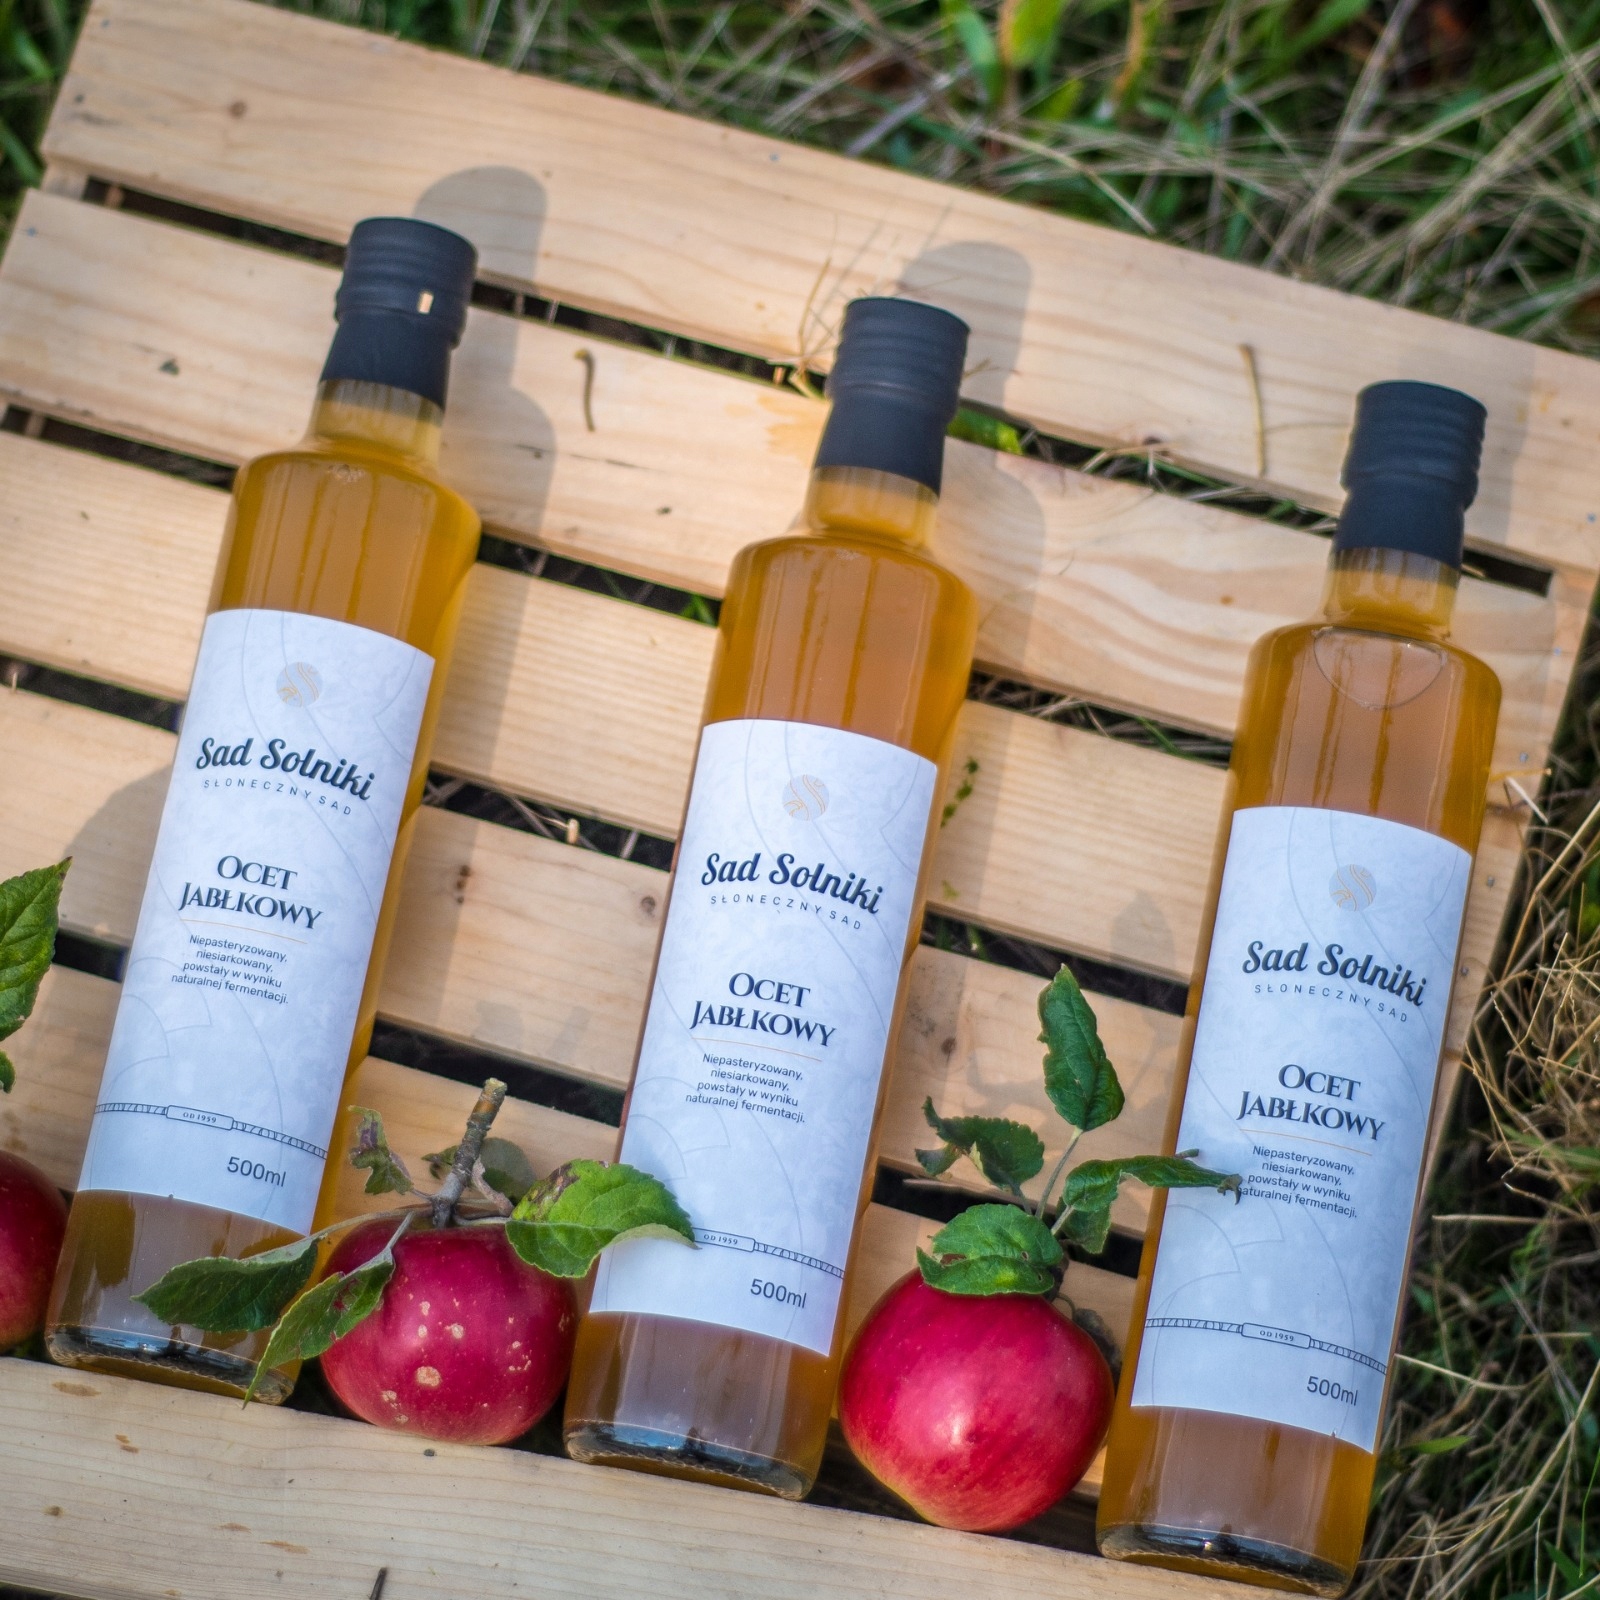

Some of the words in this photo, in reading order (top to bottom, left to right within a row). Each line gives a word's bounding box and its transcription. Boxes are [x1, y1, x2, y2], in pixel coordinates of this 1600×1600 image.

[196, 737, 254, 770] Sad
[260, 738, 375, 801] Solniki
[203, 777, 312, 799] SŁONECZNY
[319, 795, 352, 816] SAD
[217, 855, 298, 890] OCET
[701, 852, 762, 886] Sad
[768, 853, 883, 914] Solniki
[178, 882, 323, 930] JABŁKOWY
[710, 893, 822, 914] SŁONECZNY
[829, 910, 861, 930] SAD
[171, 974, 222, 990] naturalnej
[224, 980, 289, 1004] fermentacji.
[182, 962, 230, 977] powstały
[232, 970, 241, 978] w
[244, 972, 282, 988] wyniku
[728, 972, 811, 1008] OCET
[1242, 940, 1309, 974] Sad
[1316, 943, 1427, 1007] Solniki
[1254, 983, 1370, 1007] SŁONECZNY
[1377, 1002, 1408, 1023] SAD
[689, 1000, 837, 1047] JABŁKOWY
[696, 1081, 746, 1097] powstały
[748, 1089, 758, 1097] w
[760, 1091, 799, 1107] wyniku
[1278, 1064, 1361, 1101] OCET
[183, 1111, 195, 1119] OD
[685, 1093, 739, 1110] naturalnej
[741, 1099, 805, 1123] fermentacji.
[1236, 1091, 1386, 1140] JABŁKOWY
[226, 1156, 286, 1187] 500ml
[1247, 1174, 1299, 1191] powstały
[1301, 1183, 1311, 1192] w
[1313, 1185, 1351, 1202] wyniku
[1295, 1194, 1357, 1218] fermentacji.
[750, 1278, 807, 1309] 500ml
[1306, 1375, 1359, 1406] 500ml
